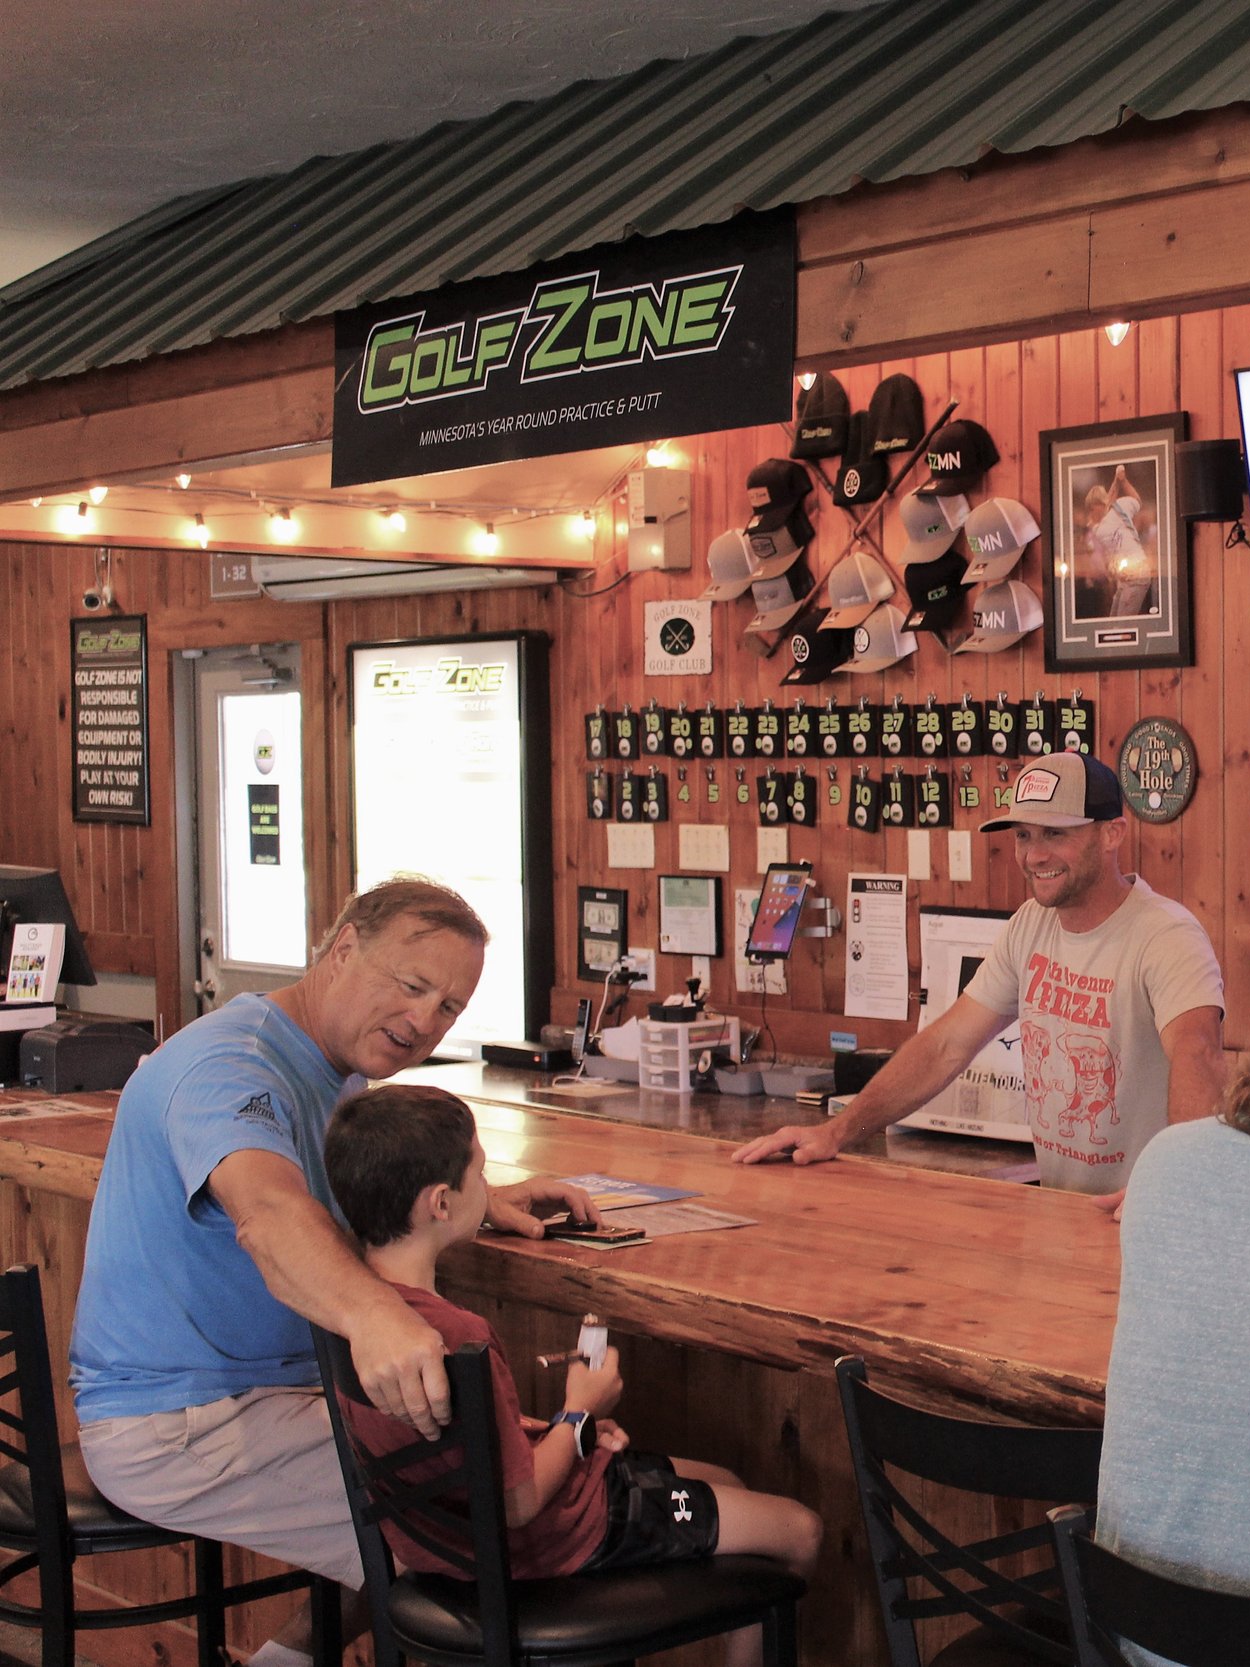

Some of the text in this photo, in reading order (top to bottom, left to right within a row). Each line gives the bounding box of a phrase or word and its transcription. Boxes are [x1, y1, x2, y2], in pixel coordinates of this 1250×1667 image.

[360, 274, 735, 409] GOLF ZONE
[419, 391, 662, 447] MINNESOTA'S YEAR ROUND PRACTICE & PUTT
[679, 658, 706, 670] CLUB
[75, 669, 142, 686] GOLF ZONE IS NOT
[436, 659, 506, 694] ZONE
[80, 690, 137, 706] RESPONSIBLE
[79, 710, 140, 725] FOR DAMAGED
[645, 713, 660, 732] 19
[671, 717, 691, 736] 20
[700, 717, 715, 736] 21
[728, 716, 749, 735] 22
[758, 715, 778, 735] 23
[788, 714, 810, 735] 24
[819, 714, 840, 734] 25
[849, 712, 871, 733] 26
[883, 712, 904, 733] 27
[917, 712, 940, 732] 28
[952, 710, 976, 731] 29
[988, 710, 1013, 732] 30
[1025, 709, 1045, 730] 31
[1061, 708, 1087, 730] 32
[78, 730, 142, 745] EQUIPMENT OR
[589, 719, 603, 737] 17
[617, 719, 632, 738] 18
[1147, 736, 1166, 749] The
[77, 750, 142, 766] BODILY INJURY!
[1144, 749, 1171, 770] 19th
[80, 770, 139, 786] PLAY AT YOUR
[1140, 769, 1173, 790] Hole
[88, 790, 133, 806] OWN RISK!
[622, 782, 632, 799] 2
[648, 782, 657, 800] 3
[677, 784, 690, 802] 4
[708, 784, 719, 802] 5
[737, 784, 749, 803] 6
[766, 781, 777, 800] 7
[793, 781, 805, 800] 8
[828, 784, 842, 805] 9
[856, 784, 871, 806] 10
[889, 782, 902, 802] 11
[922, 782, 940, 801] 12
[959, 786, 980, 807] 13
[994, 786, 1014, 808] 14
[865, 881, 900, 891] WARNING
